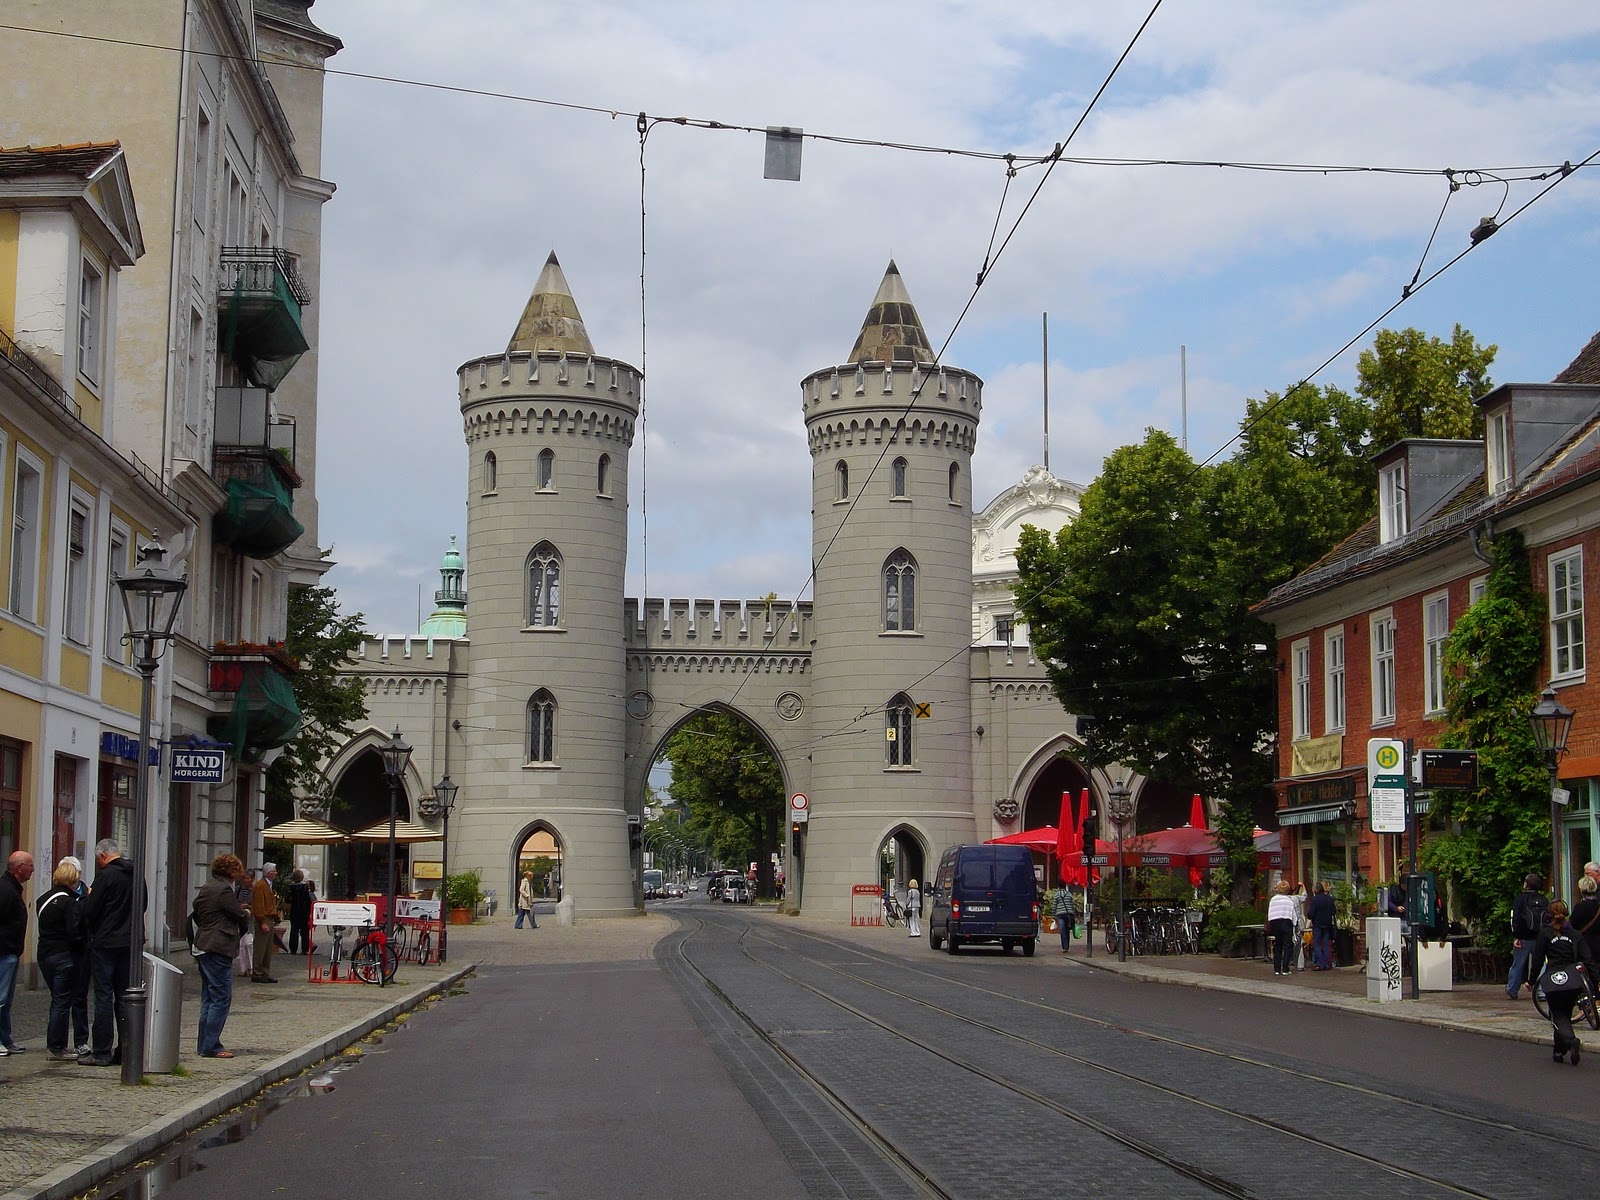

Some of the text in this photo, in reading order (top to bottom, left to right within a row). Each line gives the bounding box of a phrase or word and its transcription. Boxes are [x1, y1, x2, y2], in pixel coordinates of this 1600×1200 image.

[175, 755, 221, 769] KIND
[1382, 751, 1393, 764] H
[174, 769, 220, 778] HÖRGERÄTE
[1081, 856, 1108, 864] RAAZZOTTI
[1142, 856, 1170, 864] RAMAZZOTTI
